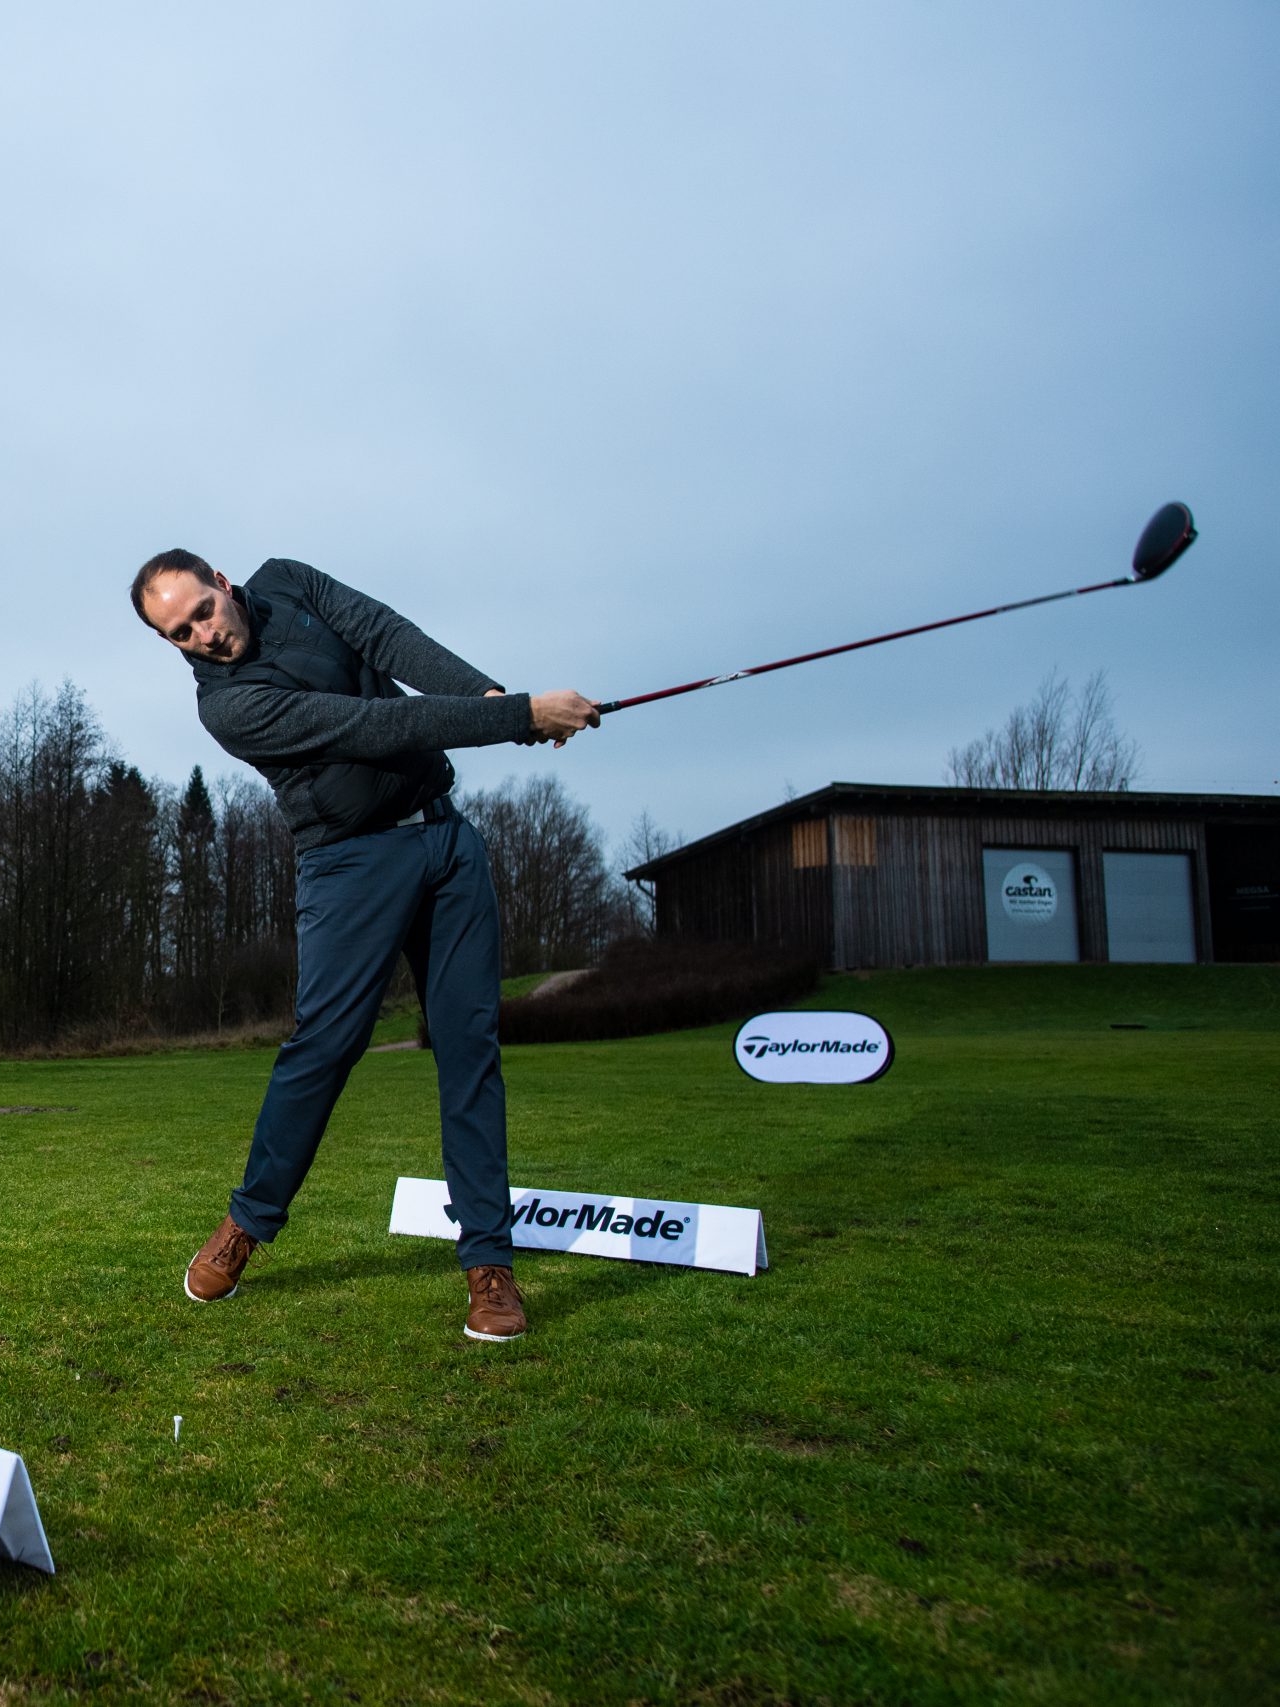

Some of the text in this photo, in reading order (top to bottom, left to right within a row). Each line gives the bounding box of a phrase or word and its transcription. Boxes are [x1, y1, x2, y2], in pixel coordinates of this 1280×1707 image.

[1005, 881, 1052, 898] castan
[743, 1035, 879, 1058] TaylorMade
[444, 1198, 684, 1241] ylorMade
